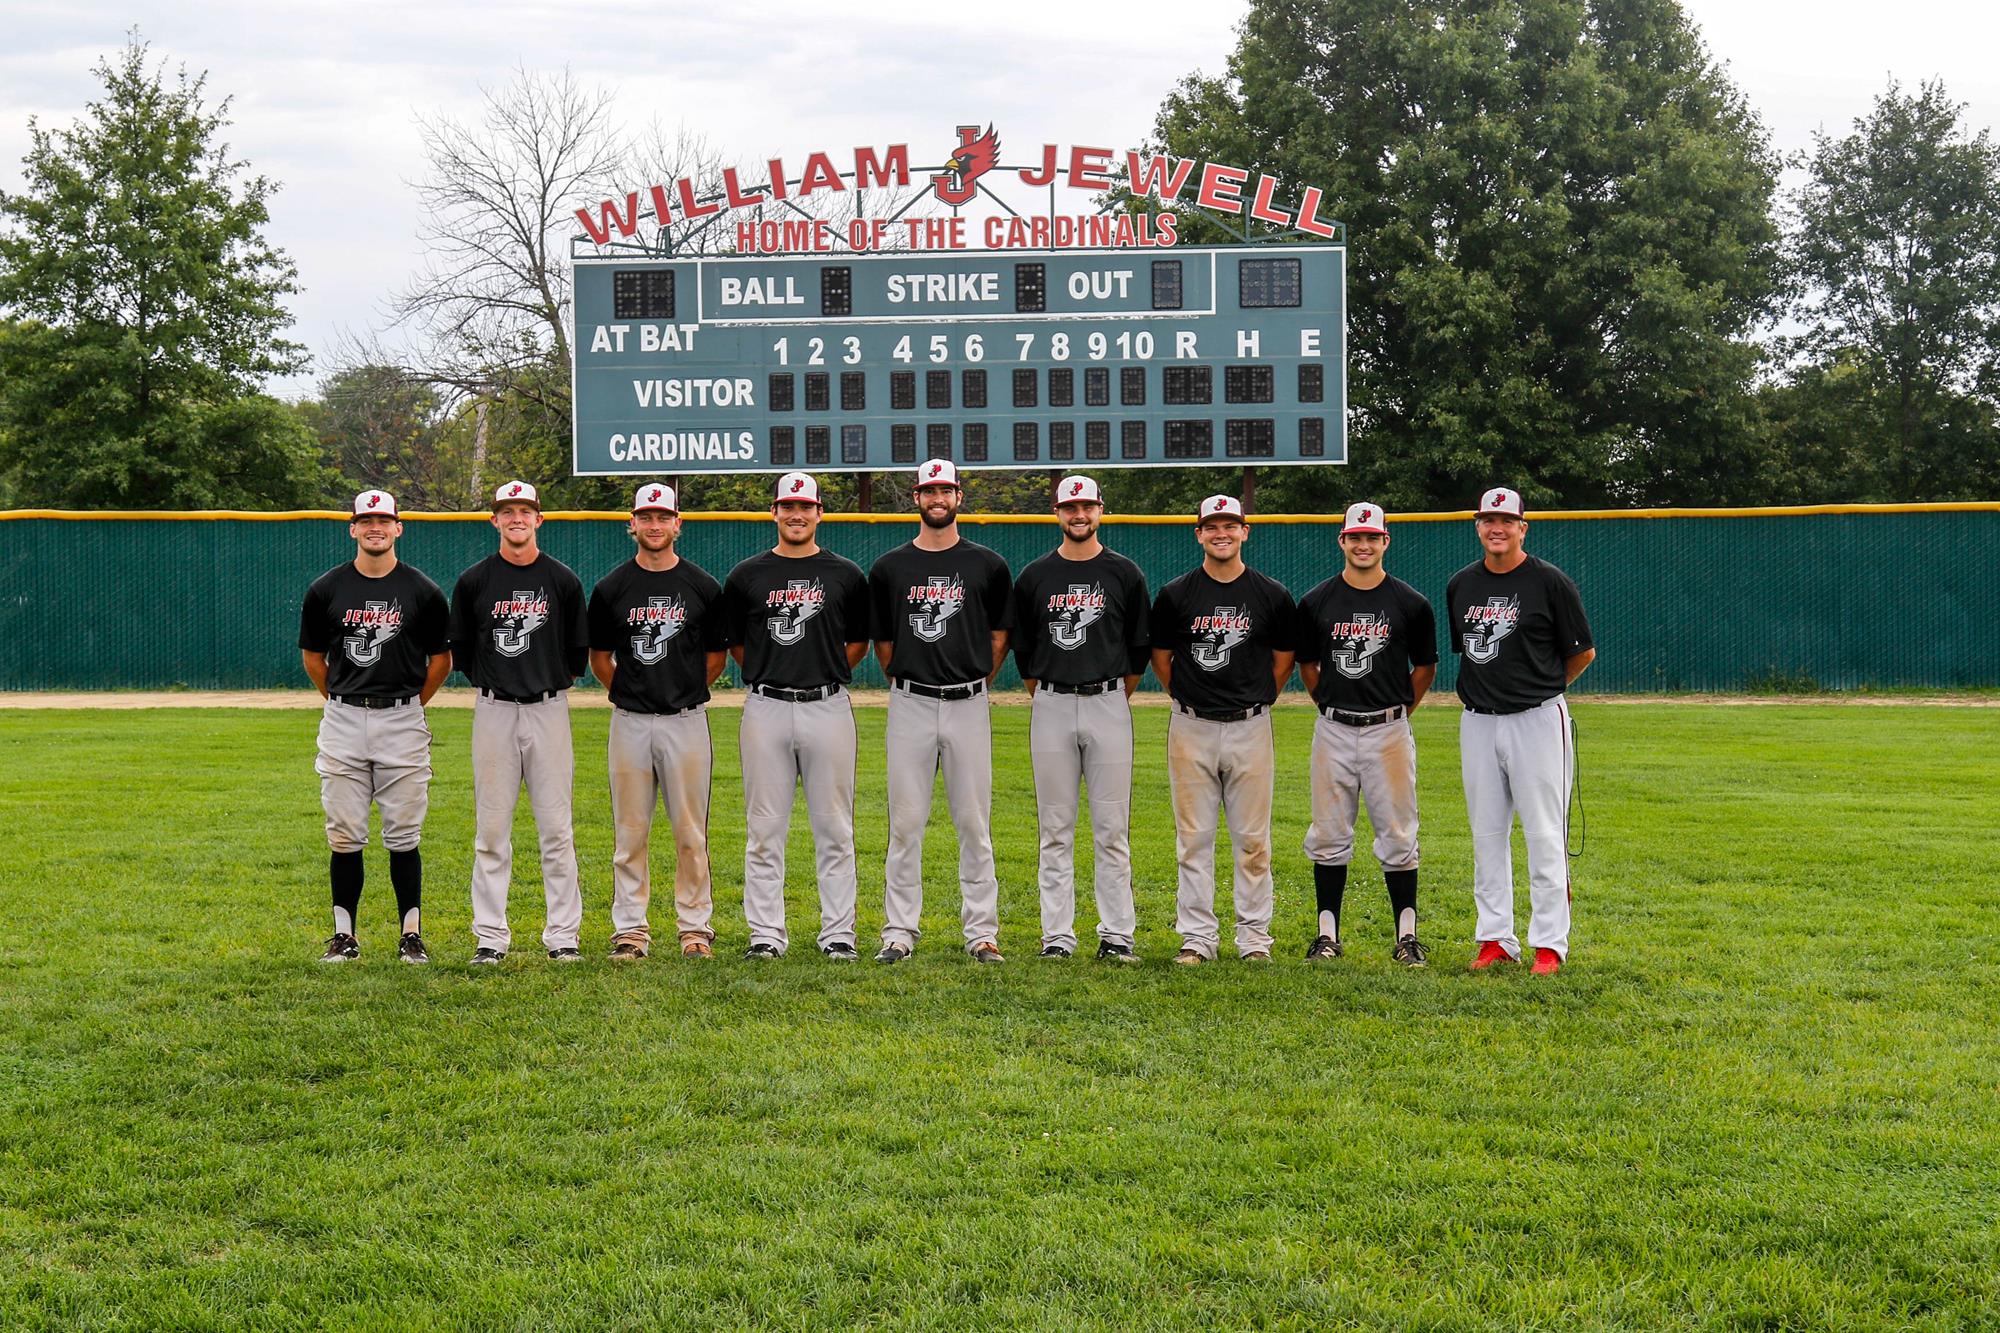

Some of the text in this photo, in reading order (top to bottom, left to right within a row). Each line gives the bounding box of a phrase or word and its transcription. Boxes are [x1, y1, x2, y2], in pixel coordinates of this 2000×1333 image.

[574, 143, 1336, 246] WILLIAM JEWELL
[736, 212, 1178, 254] HOME OF THE CARDINALS
[721, 270, 1133, 305] BALL STRIKE OUT
[590, 324, 699, 353] AT BAT
[773, 329, 1321, 365] 1 2 3 4 5 6 7 8 9 10 R H E
[633, 378, 754, 407] VISITOR
[609, 432, 754, 462] CARDINALS
[766, 590, 823, 605] JEWELL
[907, 586, 963, 601] JEWELL
[1047, 594, 1104, 609] JEWELL
[491, 600, 548, 616] JEWELL
[627, 607, 684, 623] JEWELL
[1464, 606, 1518, 621] JEWELL
[343, 609, 400, 625] JEWELL
[1191, 616, 1249, 631] JEWELL
[1331, 622, 1389, 638] JEWELL
